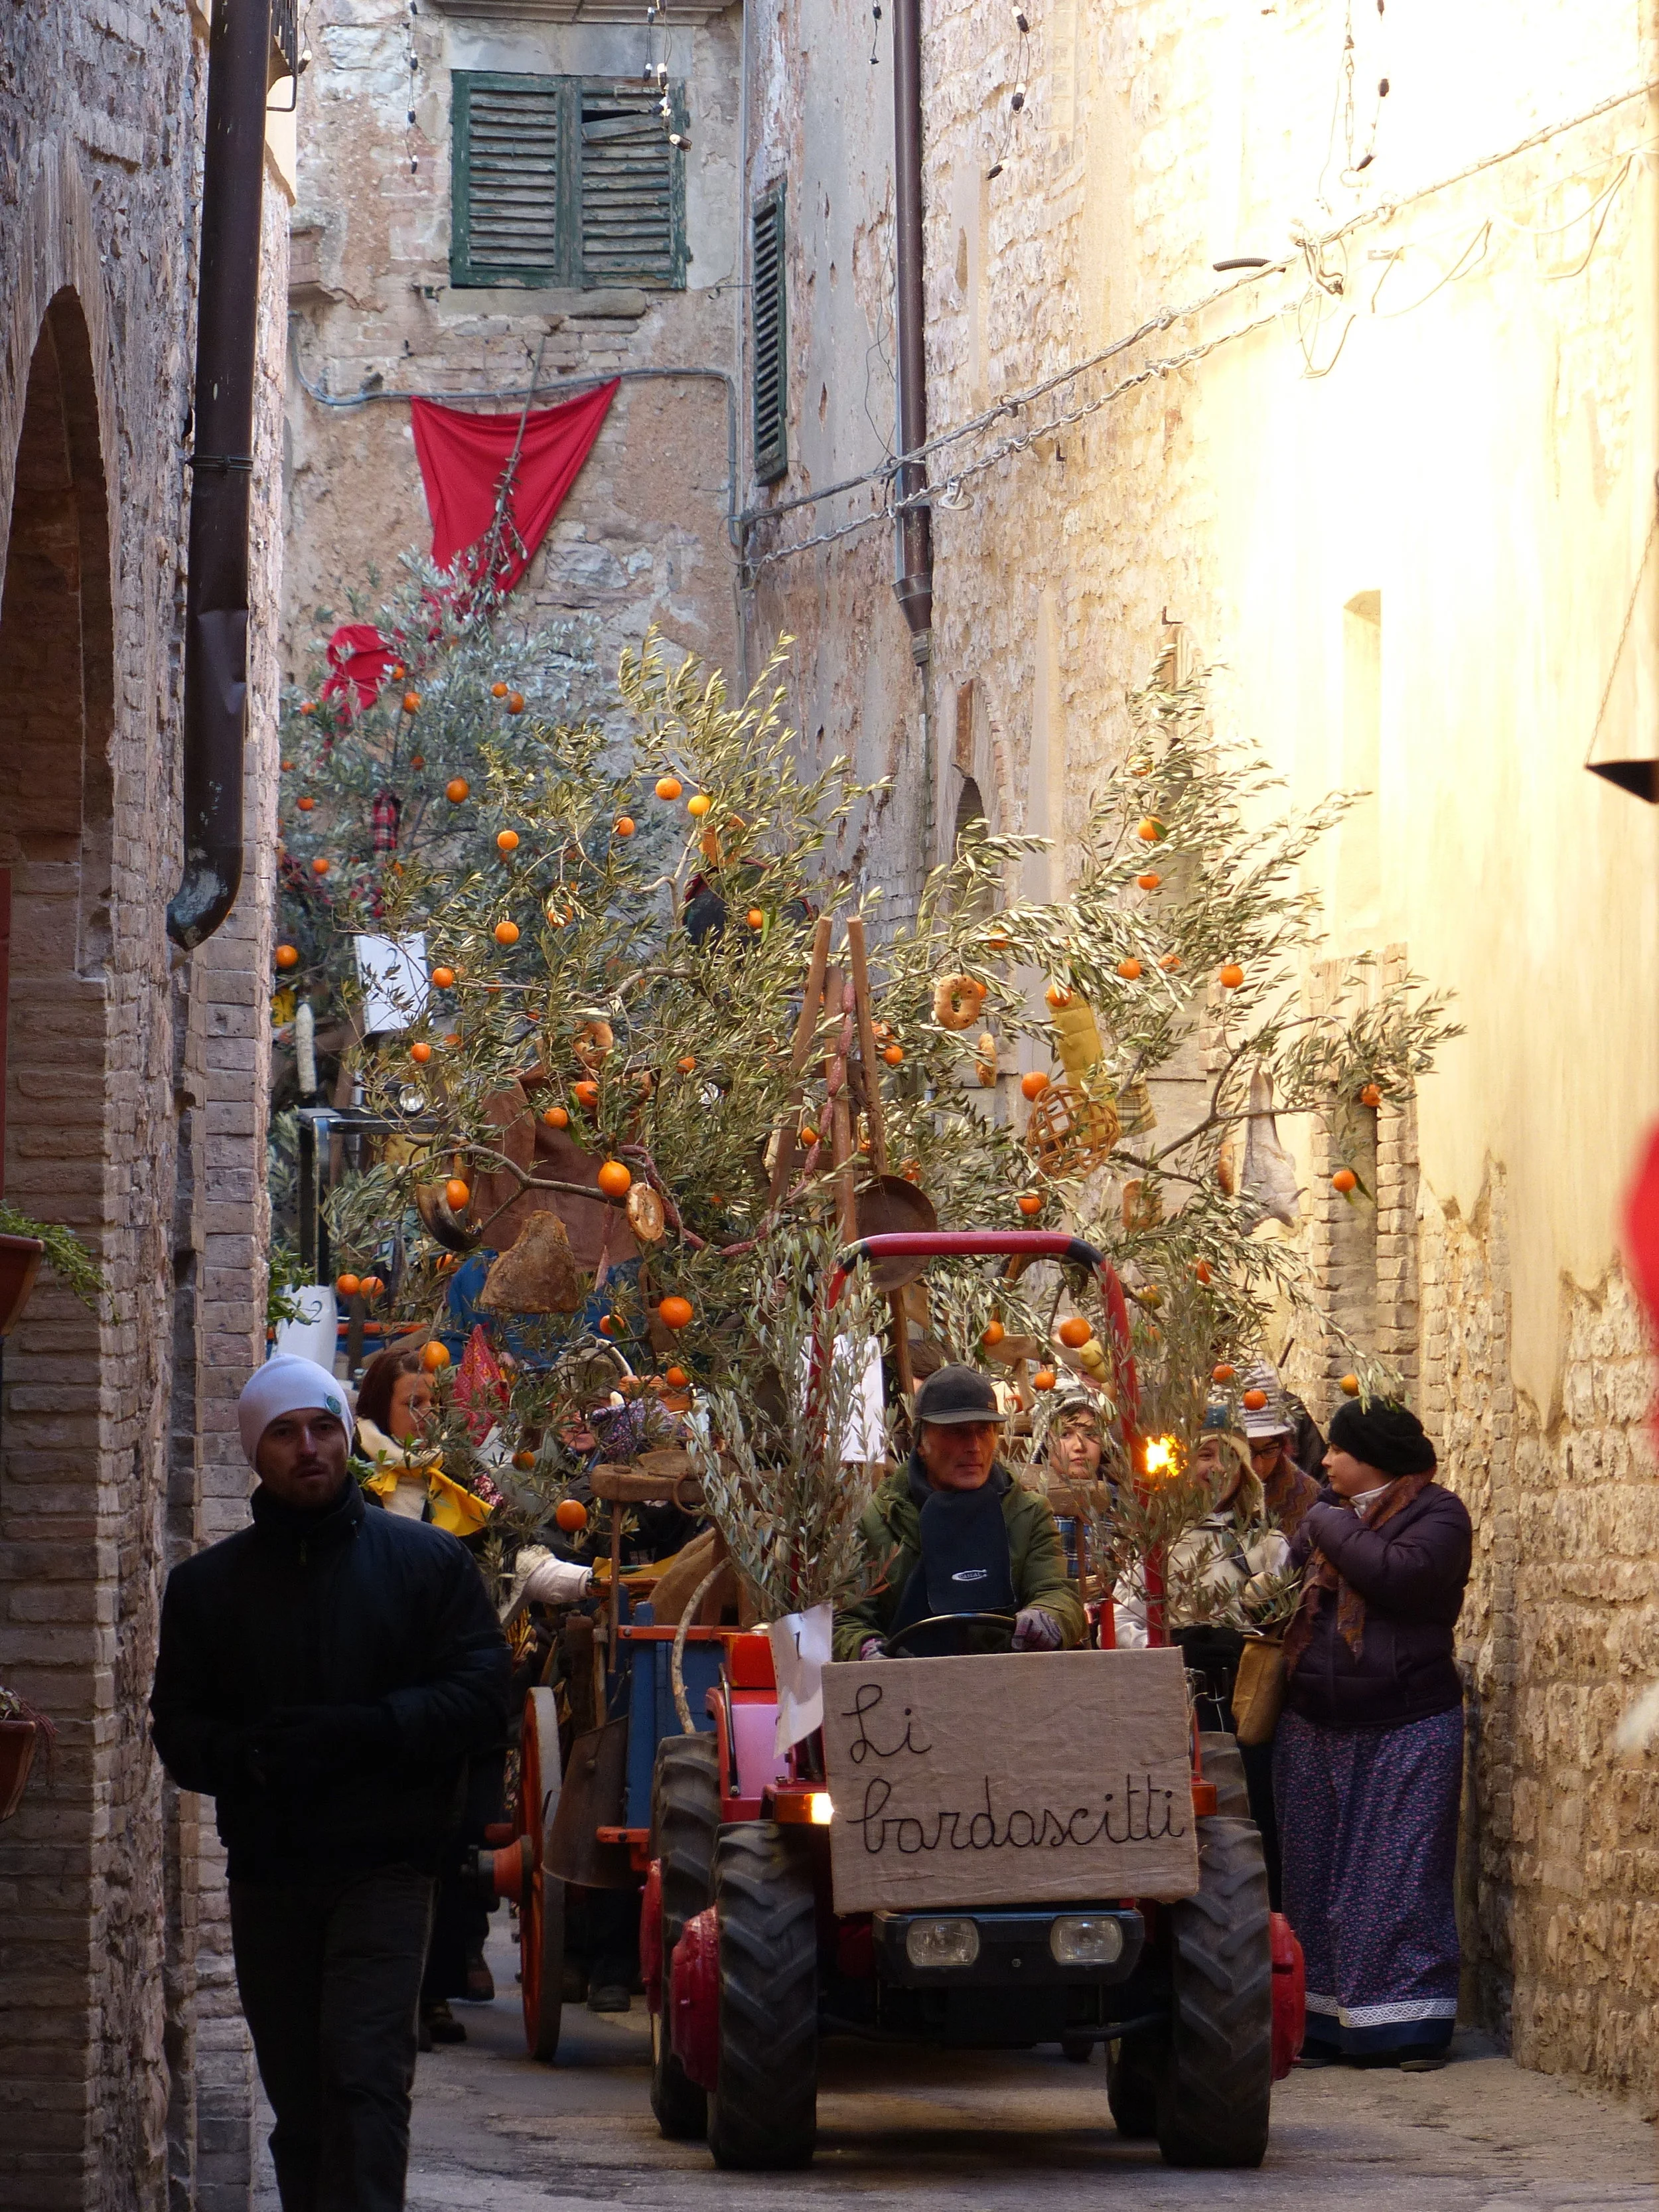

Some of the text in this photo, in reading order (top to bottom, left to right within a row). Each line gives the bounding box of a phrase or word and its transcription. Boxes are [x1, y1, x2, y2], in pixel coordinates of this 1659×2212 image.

[310, 1300, 323, 1323] 2
[841, 1684, 932, 1764] Li
[847, 1773, 1185, 1854] bardascitti
